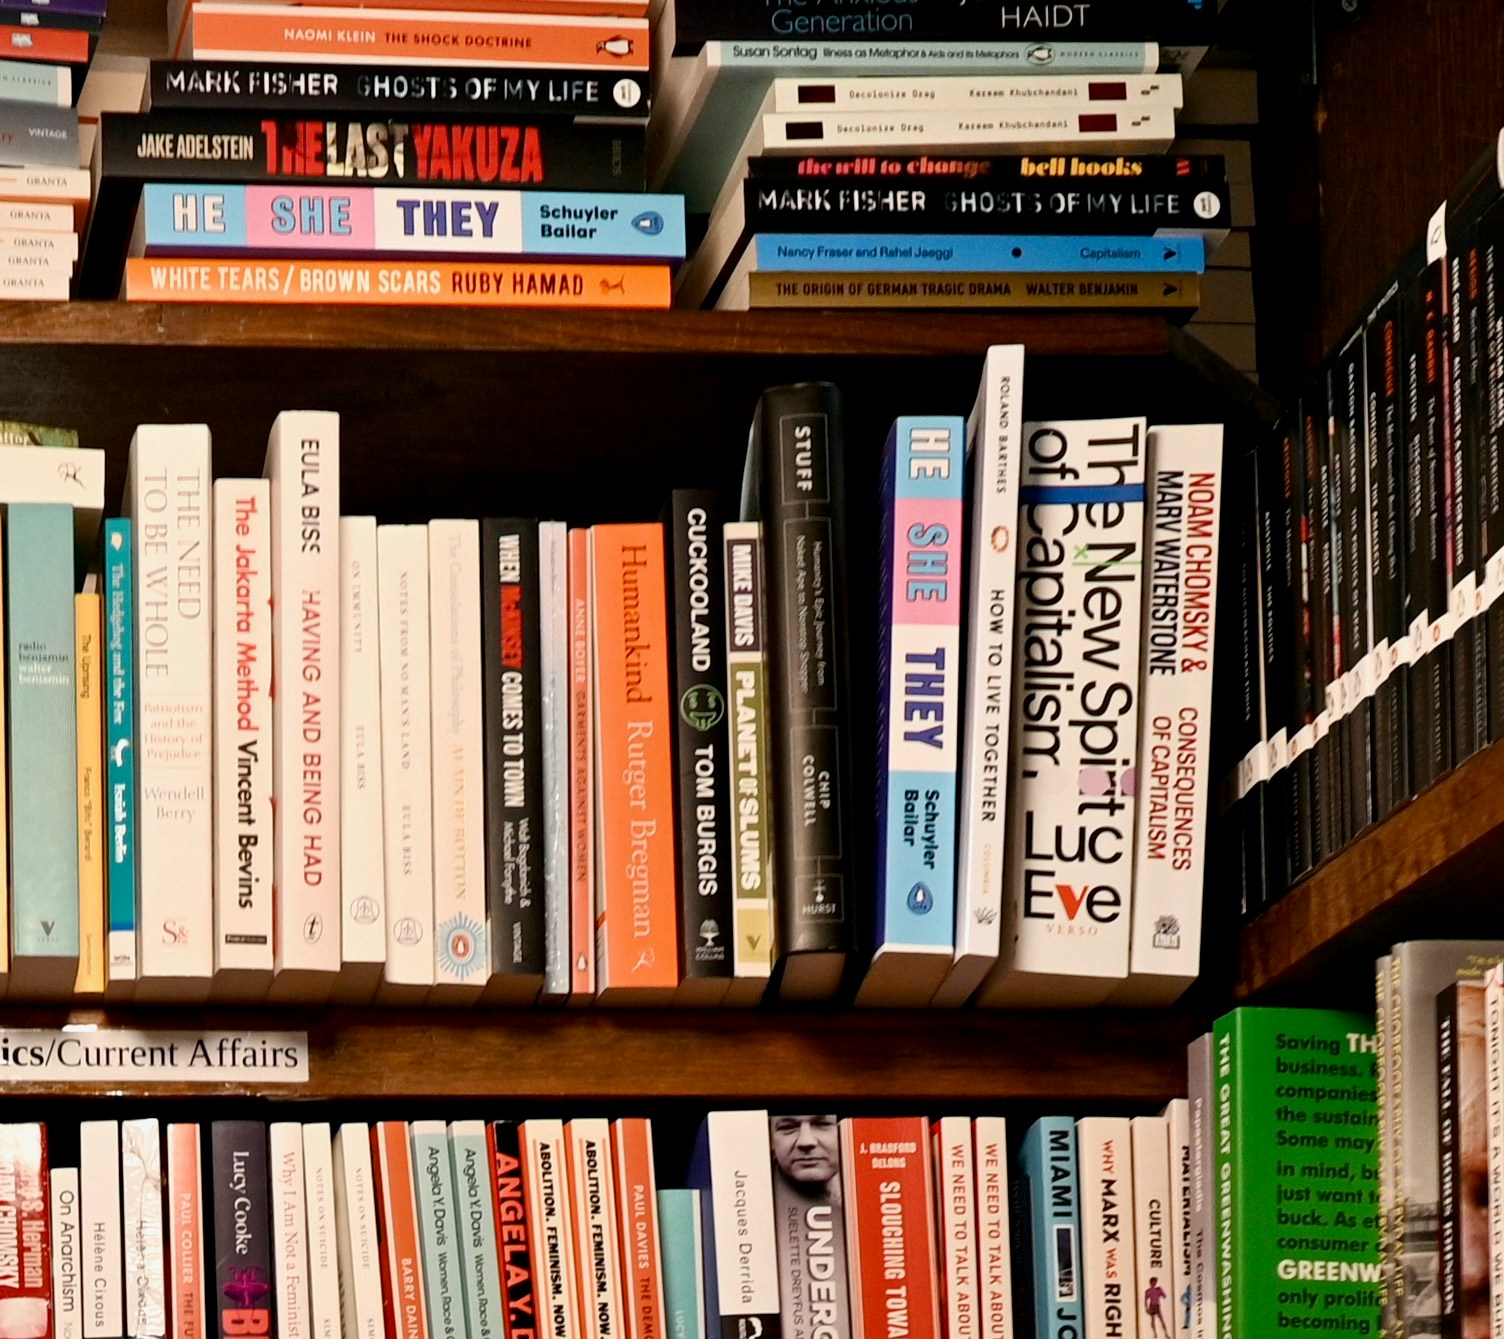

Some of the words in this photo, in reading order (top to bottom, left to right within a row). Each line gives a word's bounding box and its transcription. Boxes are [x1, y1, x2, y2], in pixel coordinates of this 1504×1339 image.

[1000, 4, 1090, 30] HAIDT
[137, 133, 174, 160] JAKE
[177, 134, 254, 161] ADELSTEIN
[172, 195, 226, 233] HE
[271, 196, 352, 236] SHE
[396, 200, 499, 239] THEY
[451, 272, 503, 293] RUBY
[512, 274, 584, 296] HAMAD
[1026, 282, 1074, 296] WALTER
[1079, 283, 1138, 297] BENJAMIN
[299, 438, 321, 499] EULA
[1184, 471, 1217, 537] NOAM
[301, 506, 321, 555] BISS
[234, 538, 253, 632] Jakarta
[686, 507, 711, 672] CUCKOOLAND
[1182, 538, 1215, 654] CHOMSKY
[621, 543, 653, 704] Humankind
[236, 642, 259, 731] Method
[237, 740, 259, 828] Vincent
[626, 719, 654, 811] Rutger
[694, 744, 718, 797] TOM
[237, 832, 260, 909] Bevins
[630, 819, 657, 939] Bregman
[696, 804, 719, 897] BURGIS
[188, 1037, 298, 1069] Affairs
[231, 1151, 250, 1198] Lucy
[539, 1142, 559, 1223] ABOLITION.
[1048, 1130, 1072, 1218] MIAMI
[233, 1200, 250, 1255] Cooke
[546, 1226, 561, 1300] FEMINISM.
